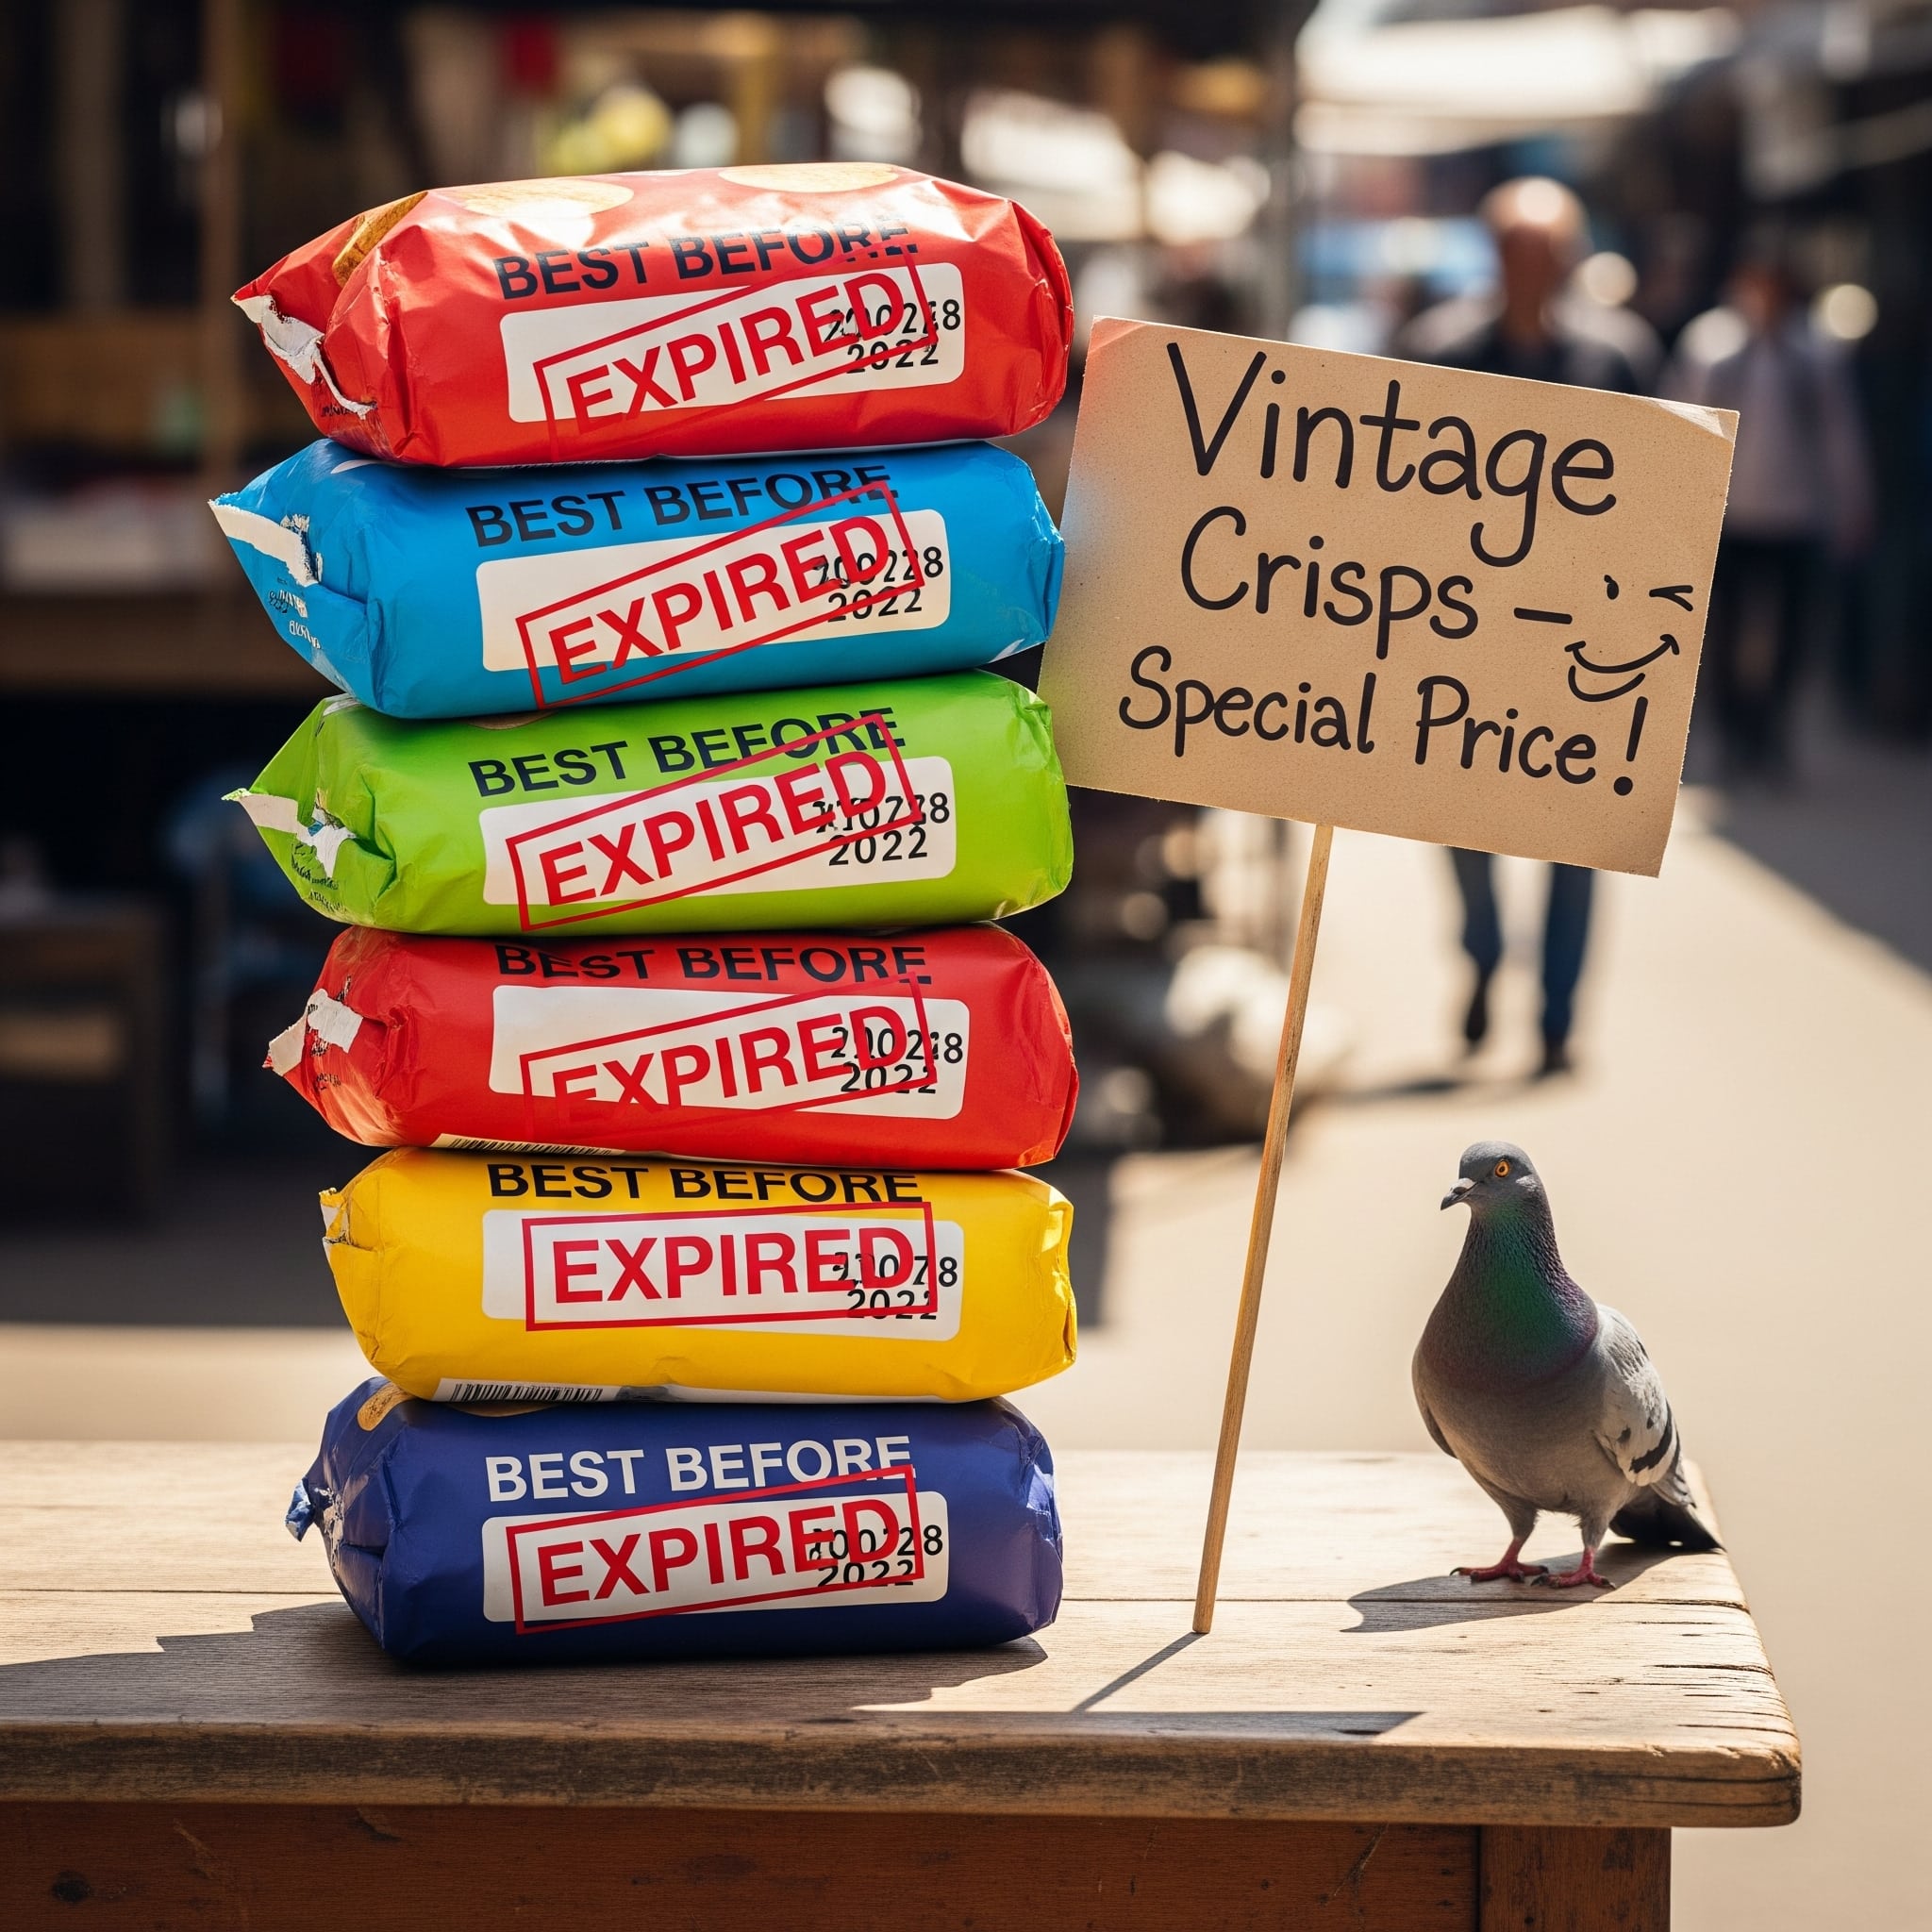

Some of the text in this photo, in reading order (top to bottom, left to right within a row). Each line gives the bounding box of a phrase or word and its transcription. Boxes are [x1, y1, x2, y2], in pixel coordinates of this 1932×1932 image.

[493, 215, 918, 299] BEST BEFORE
[567, 272, 906, 433] EXPIRED
[846, 340, 939, 374] 2022
[1166, 342, 1617, 568] Vintage
[465, 465, 899, 547] BEST BEFORE
[549, 516, 889, 685] EXPIRED
[828, 586, 922, 623] 2022
[1181, 506, 1478, 659] Crisps
[468, 708, 906, 797] BEST BEFORE
[1119, 644, 1649, 796] Special Price!
[539, 751, 887, 907] EXPIRED
[829, 825, 927, 866] 2022
[493, 944, 932, 985] BEST BEFORE
[552, 1006, 907, 1126] EXPIRED
[486, 1163, 923, 1203] BEST BEFORE
[553, 1226, 914, 1303] EXPIRED
[486, 1435, 916, 1502] BEST BEFORE
[537, 1499, 900, 1607] EXPIRED
